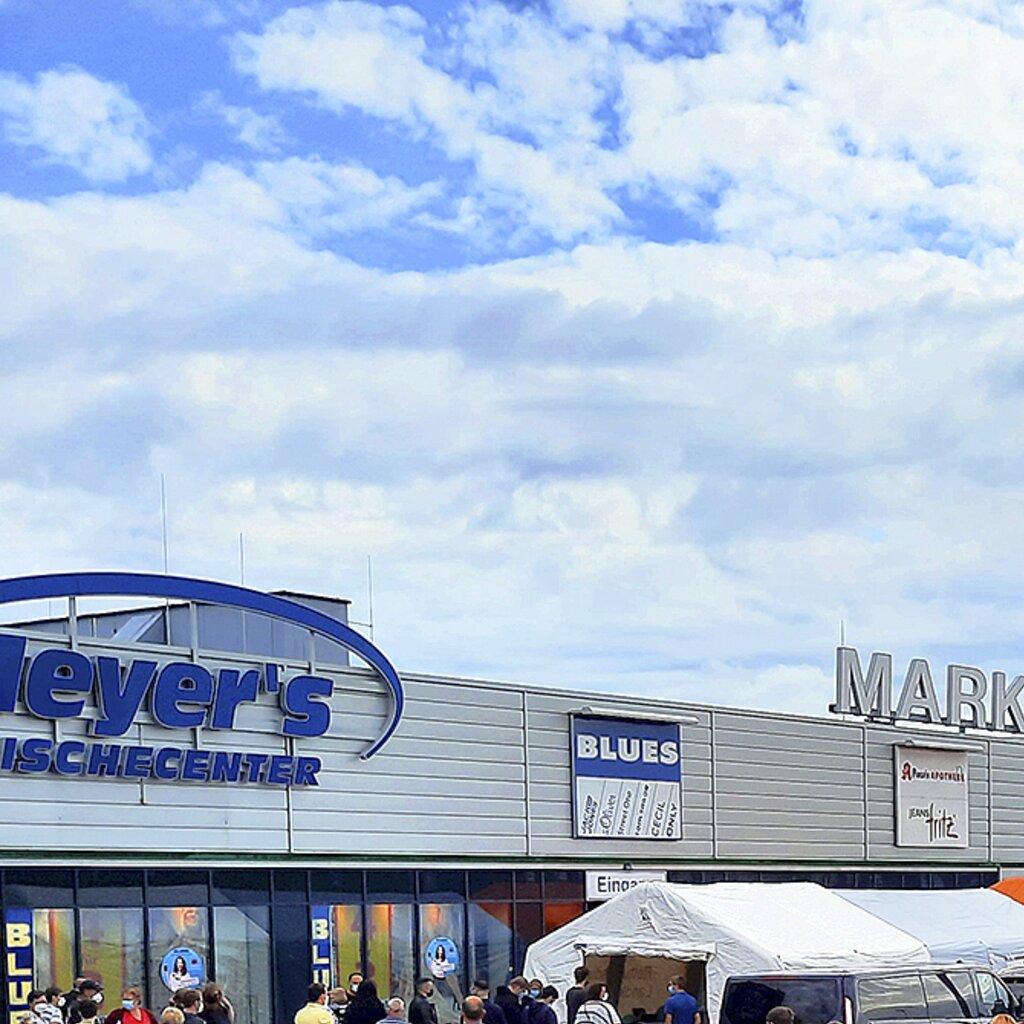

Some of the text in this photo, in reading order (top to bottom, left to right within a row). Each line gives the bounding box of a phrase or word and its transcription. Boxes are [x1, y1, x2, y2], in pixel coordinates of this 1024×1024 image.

[576, 734, 679, 765] BLUES
[666, 803, 677, 837] ONLY
[597, 876, 646, 892] Einga
